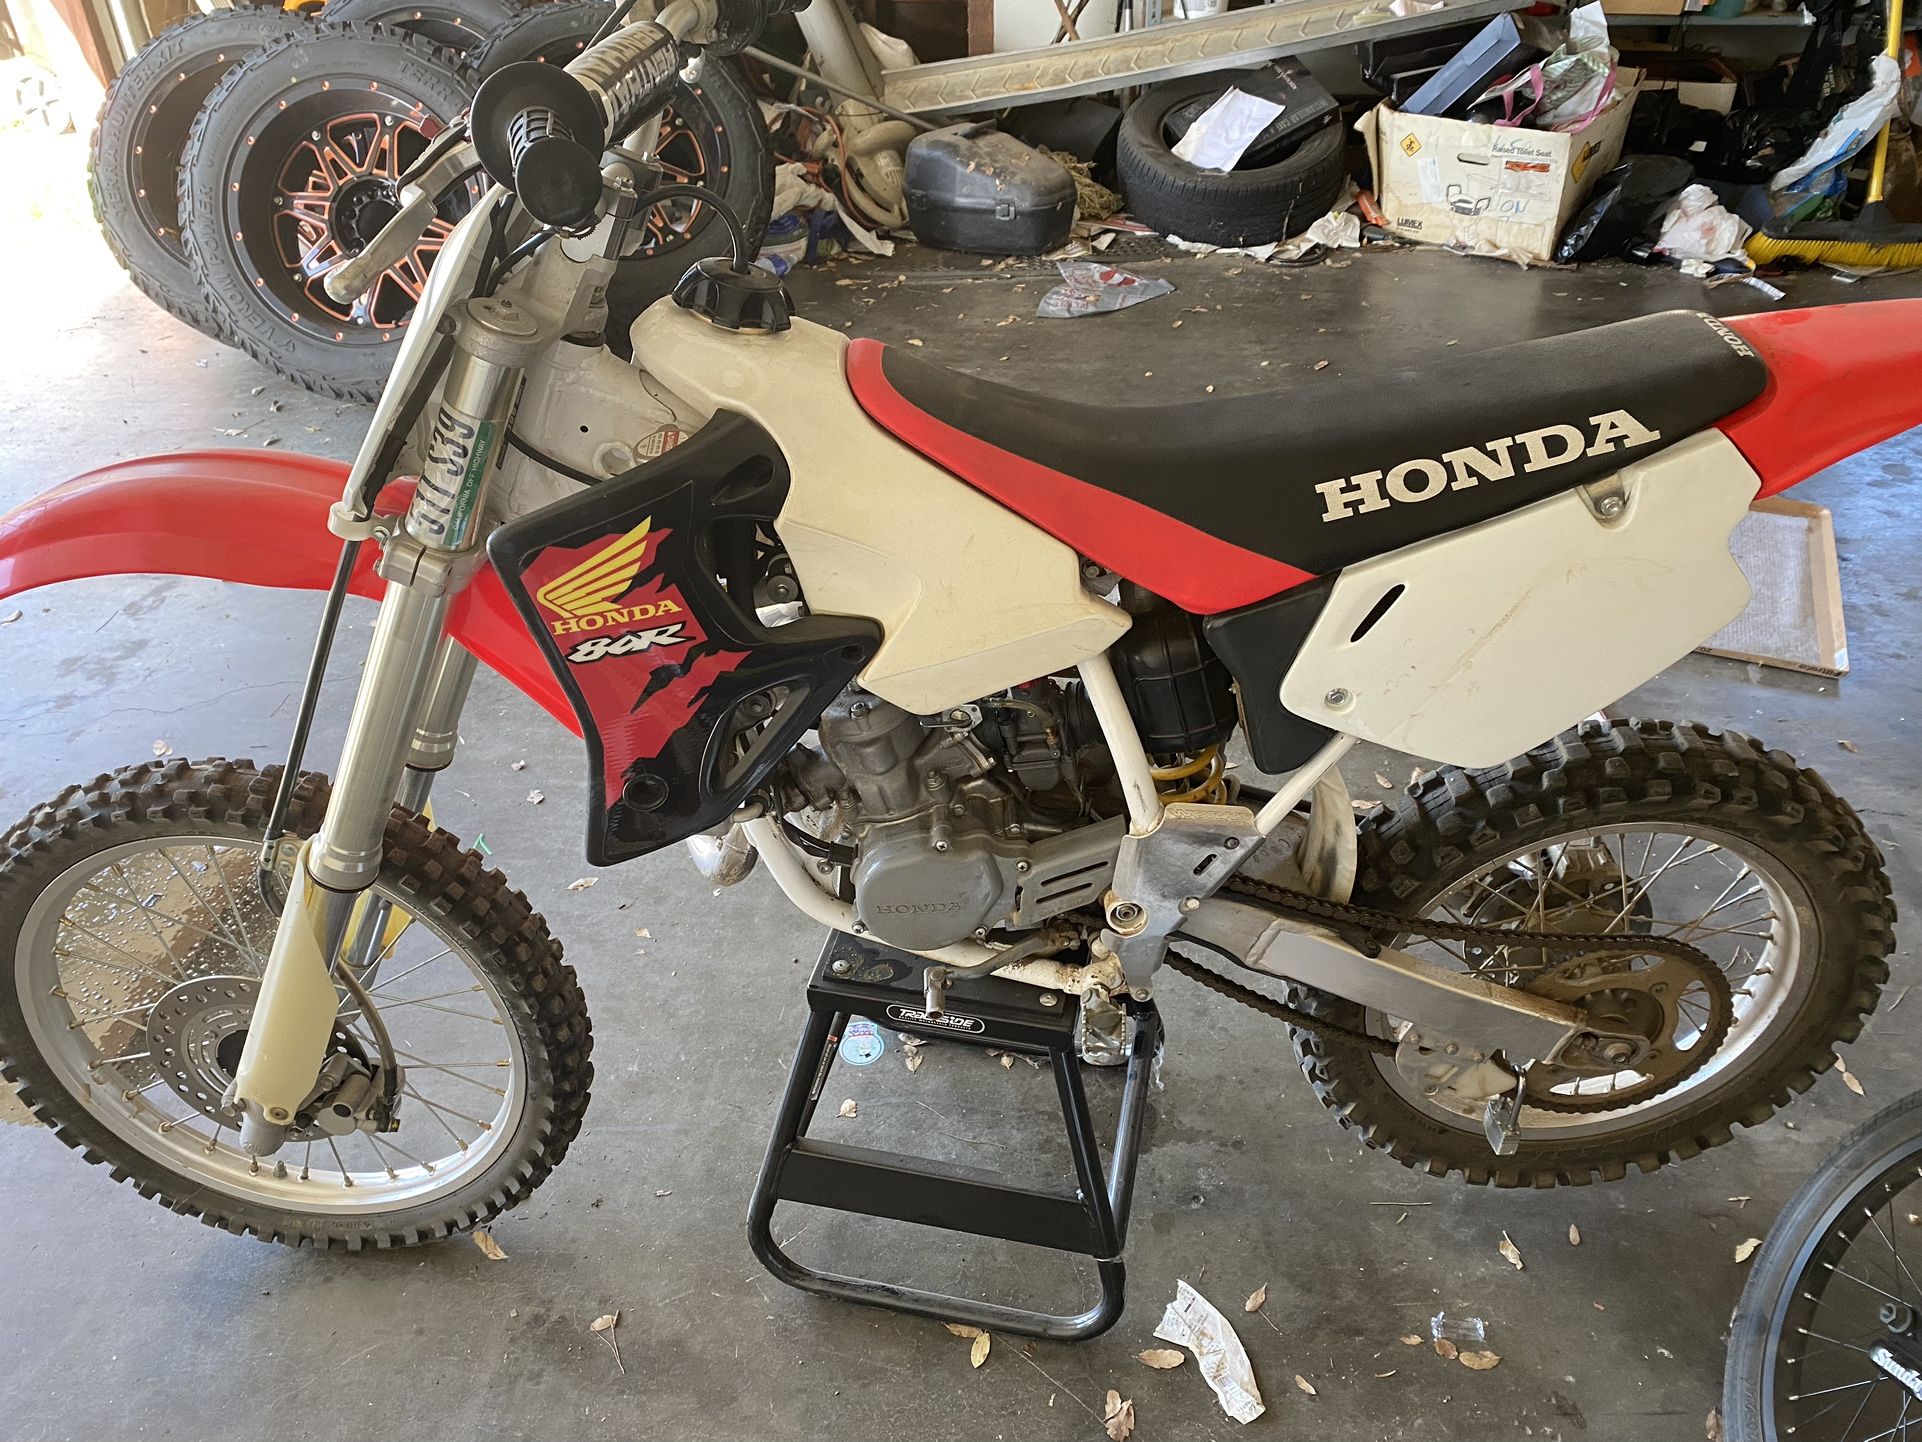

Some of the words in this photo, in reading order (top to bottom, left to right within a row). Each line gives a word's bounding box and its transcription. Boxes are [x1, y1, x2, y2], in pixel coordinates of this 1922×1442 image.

[113, 70, 155, 142] HUNTER
[1516, 147, 1534, 155] Toilet
[1536, 149, 1552, 157] Seat
[199, 183, 224, 267] POWER
[1696, 312, 1755, 357] HONDA
[453, 488, 471, 531] CALIFORNIA
[466, 473, 476, 488] OFF
[472, 439, 487, 471] HIGHWAY
[1314, 409, 1661, 523] HONDA
[551, 599, 682, 636] HONDA
[876, 902, 961, 914] HONDA
[899, 1008, 975, 1027] TRACSIDE
